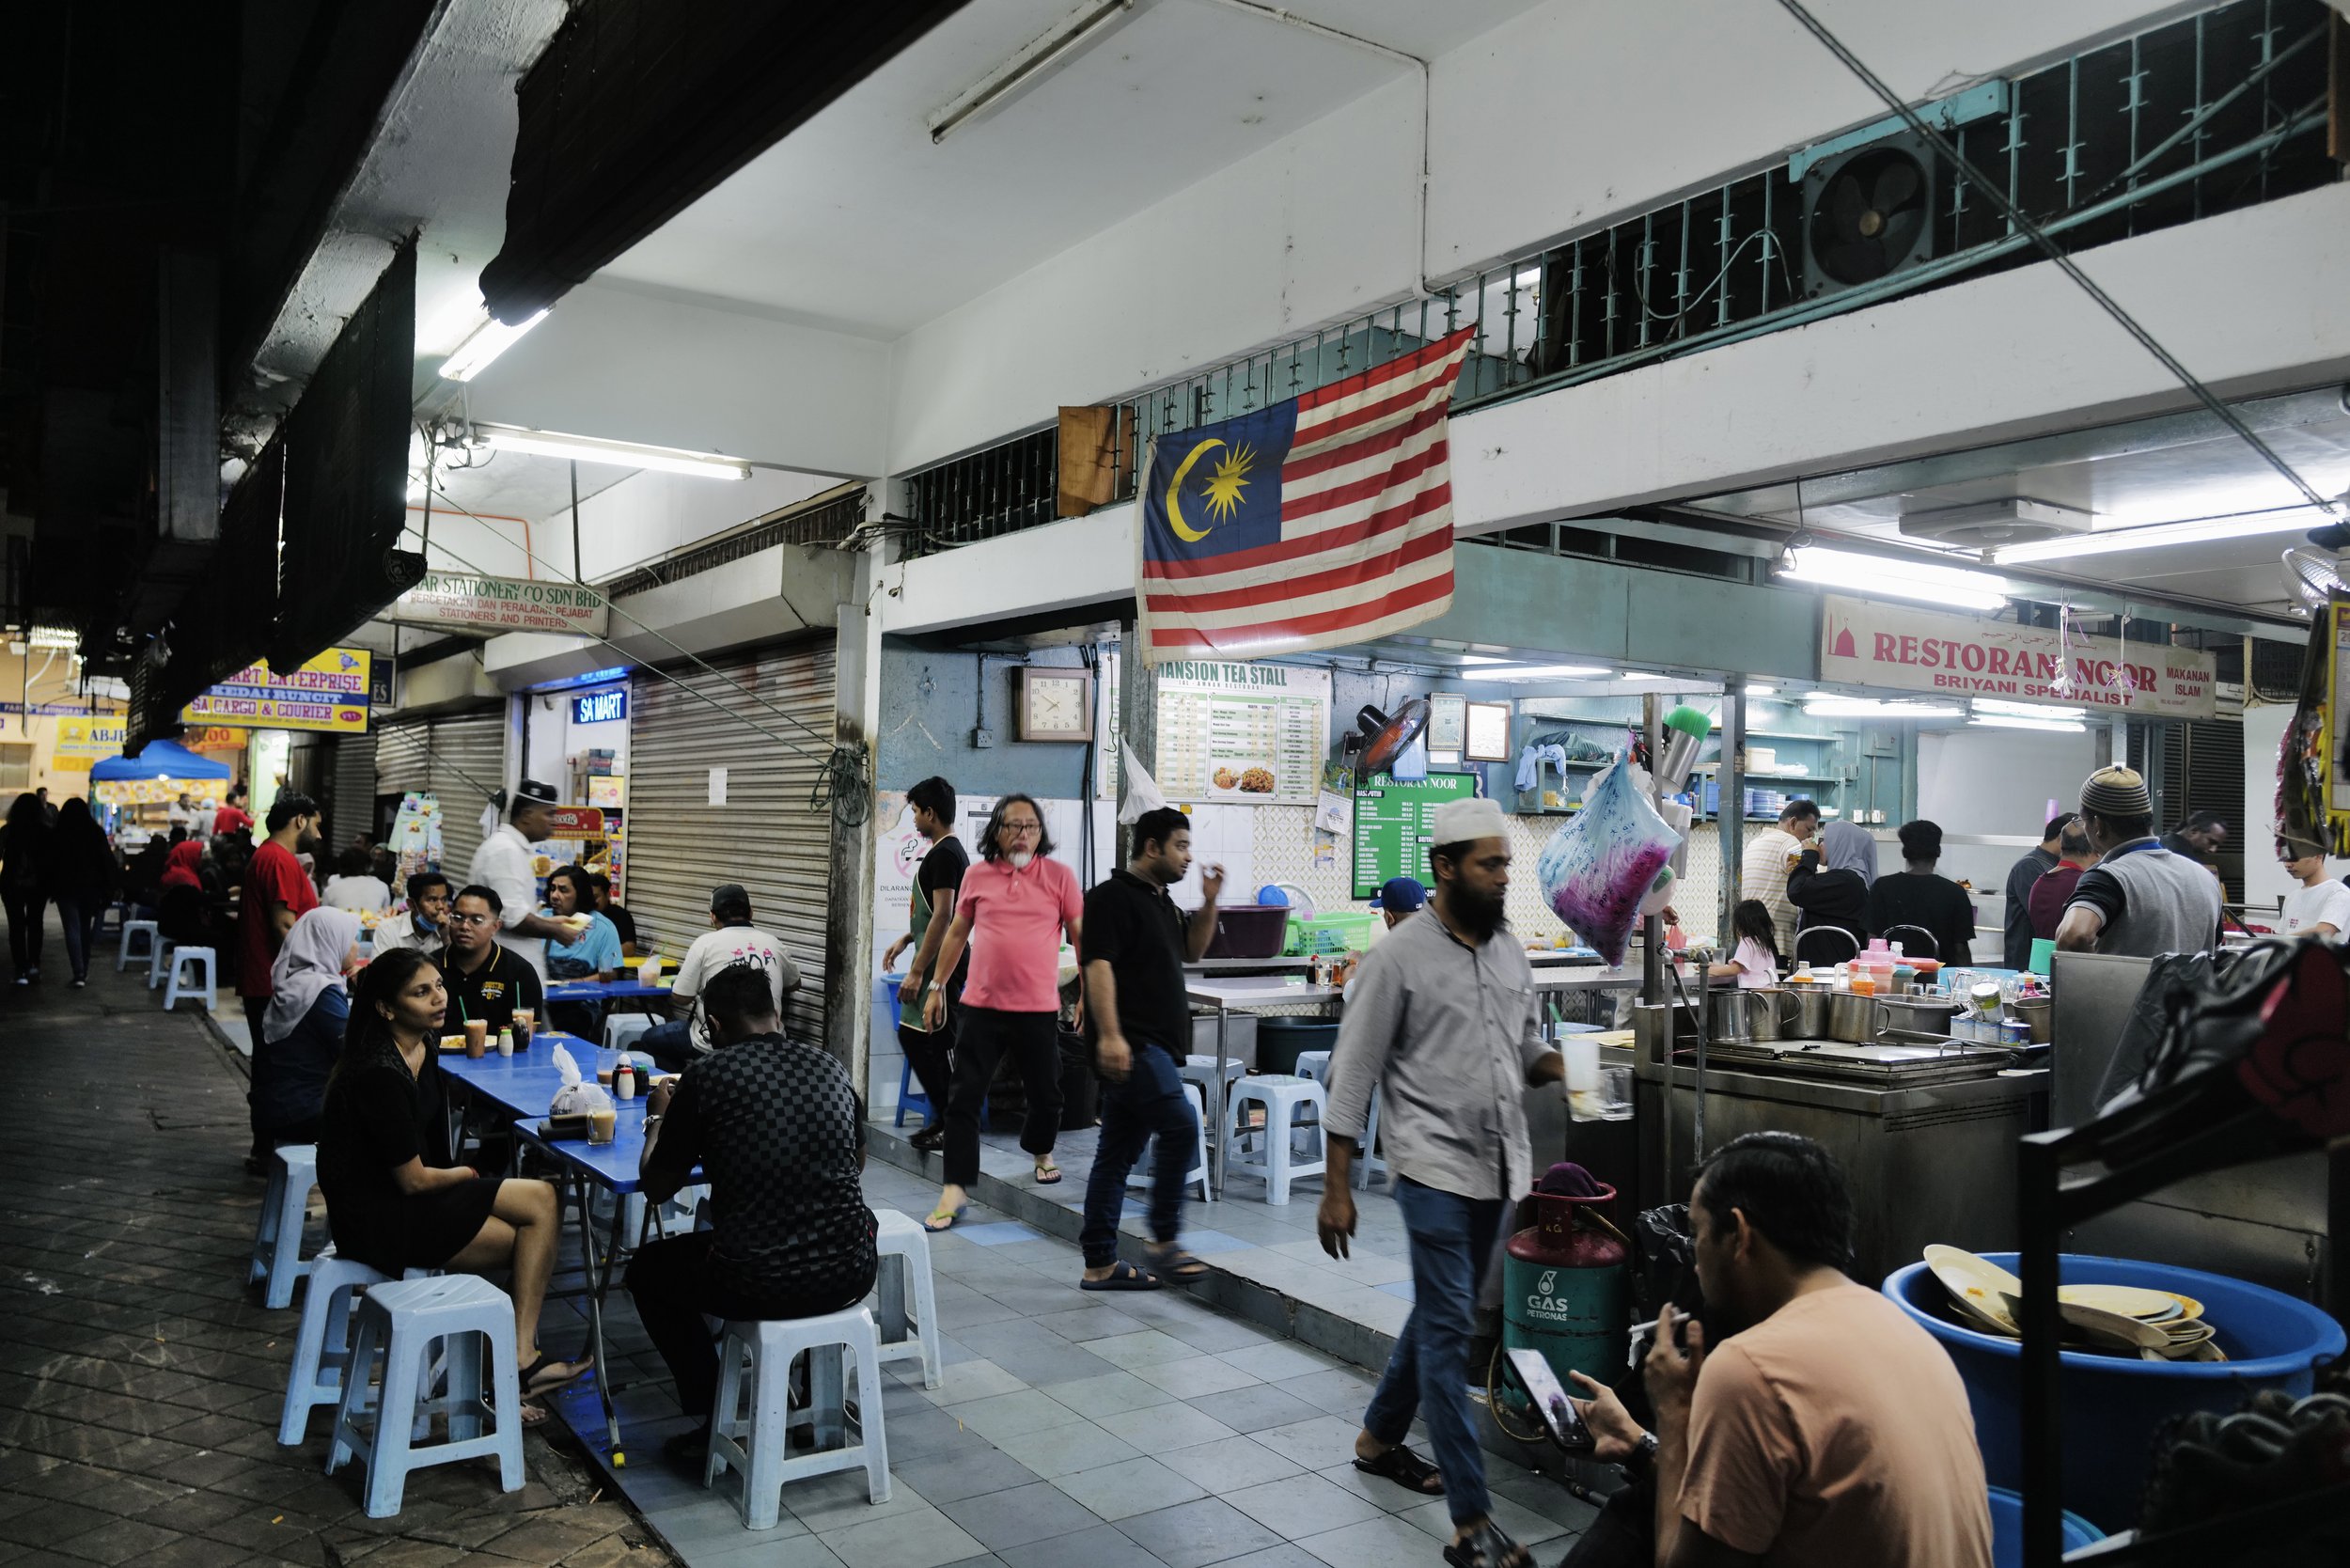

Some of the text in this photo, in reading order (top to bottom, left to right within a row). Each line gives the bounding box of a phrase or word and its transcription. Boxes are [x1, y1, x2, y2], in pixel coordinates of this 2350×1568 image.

[443, 577, 520, 602] STATIONERY
[524, 586, 542, 604] CO
[546, 588, 571, 606] SDN
[575, 590, 602, 609] BHD
[411, 592, 594, 619] PERCETAKAN DAN PERALATAN PEJABAT
[439, 607, 568, 629] STATIONERS AND PRINTERS
[1873, 632, 2157, 693] RESTORAN NOOR
[227, 668, 362, 691] ART ENTERPRISE
[1222, 665, 1246, 682] TEA
[1250, 666, 1288, 686] STALL
[1934, 674, 2018, 695] BRIYANI
[2166, 666, 2210, 683] MAKANAN
[211, 685, 342, 704] KEDAI RUNCIT
[2175, 683, 2201, 698] ISLAM
[192, 698, 208, 712] SA
[213, 699, 256, 715] CARGO
[261, 702, 272, 715] &
[277, 704, 333, 719] COURIER
[1374, 775, 1457, 790] RESTORAN NOOR
[1528, 1294, 1568, 1312] GAS
[1527, 1309, 1568, 1321] PETRONAS
